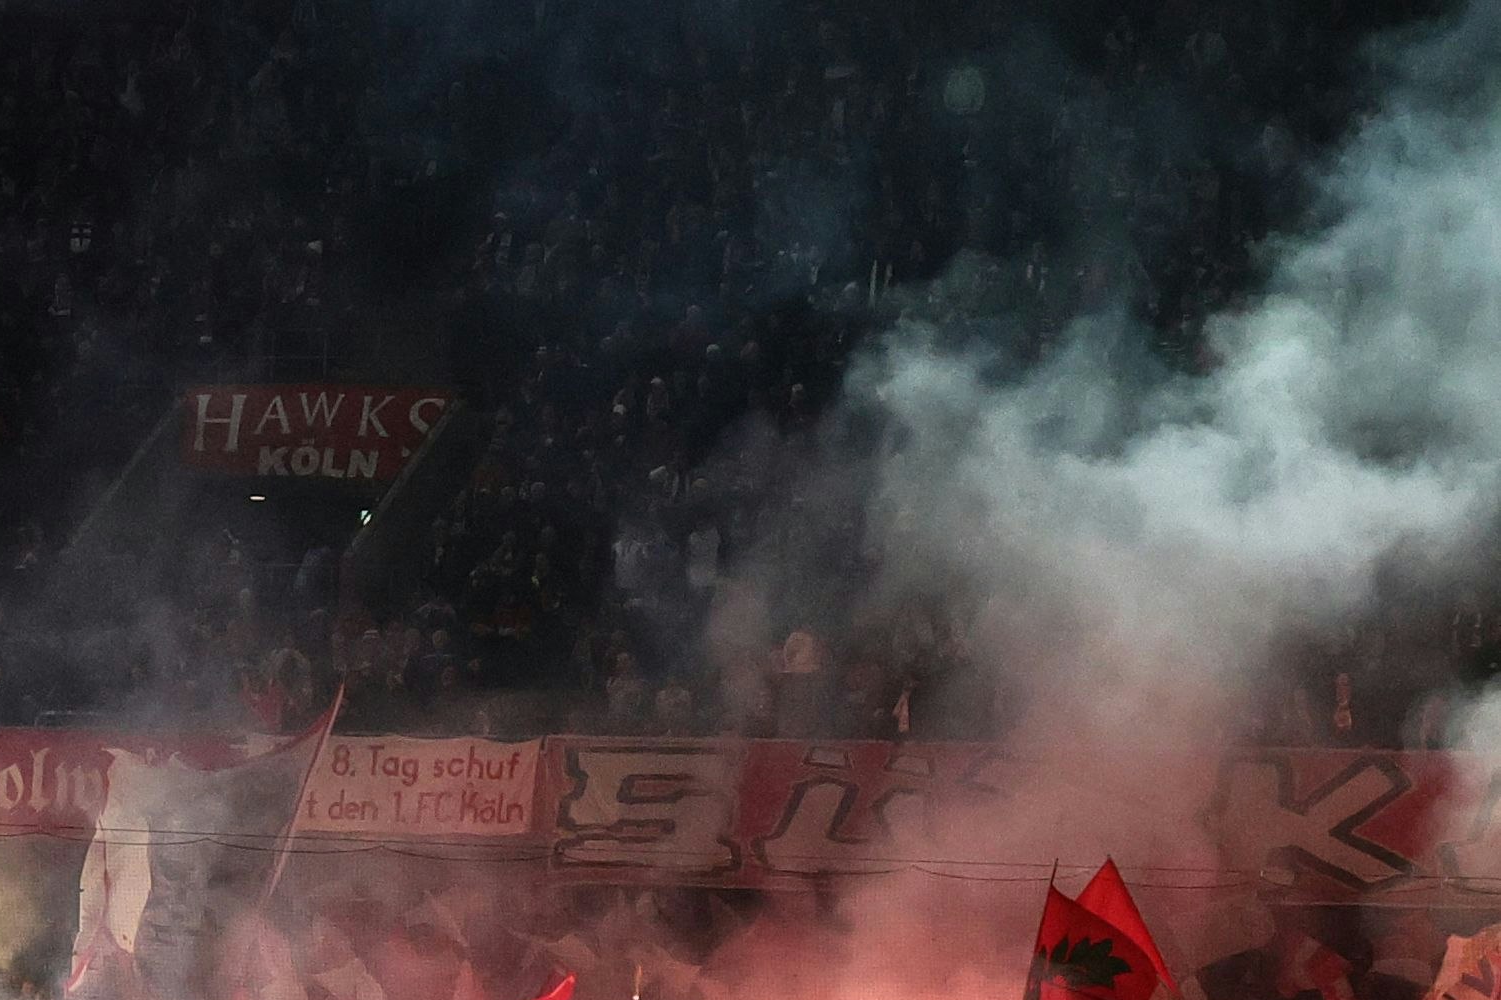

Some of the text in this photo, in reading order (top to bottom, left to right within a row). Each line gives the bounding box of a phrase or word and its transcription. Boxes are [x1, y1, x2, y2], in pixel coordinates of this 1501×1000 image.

[257, 438, 379, 479] KÖLN
[331, 744, 521, 787] 8. Tag schuf
[327, 790, 380, 822] den
[458, 783, 525, 826] Köln
